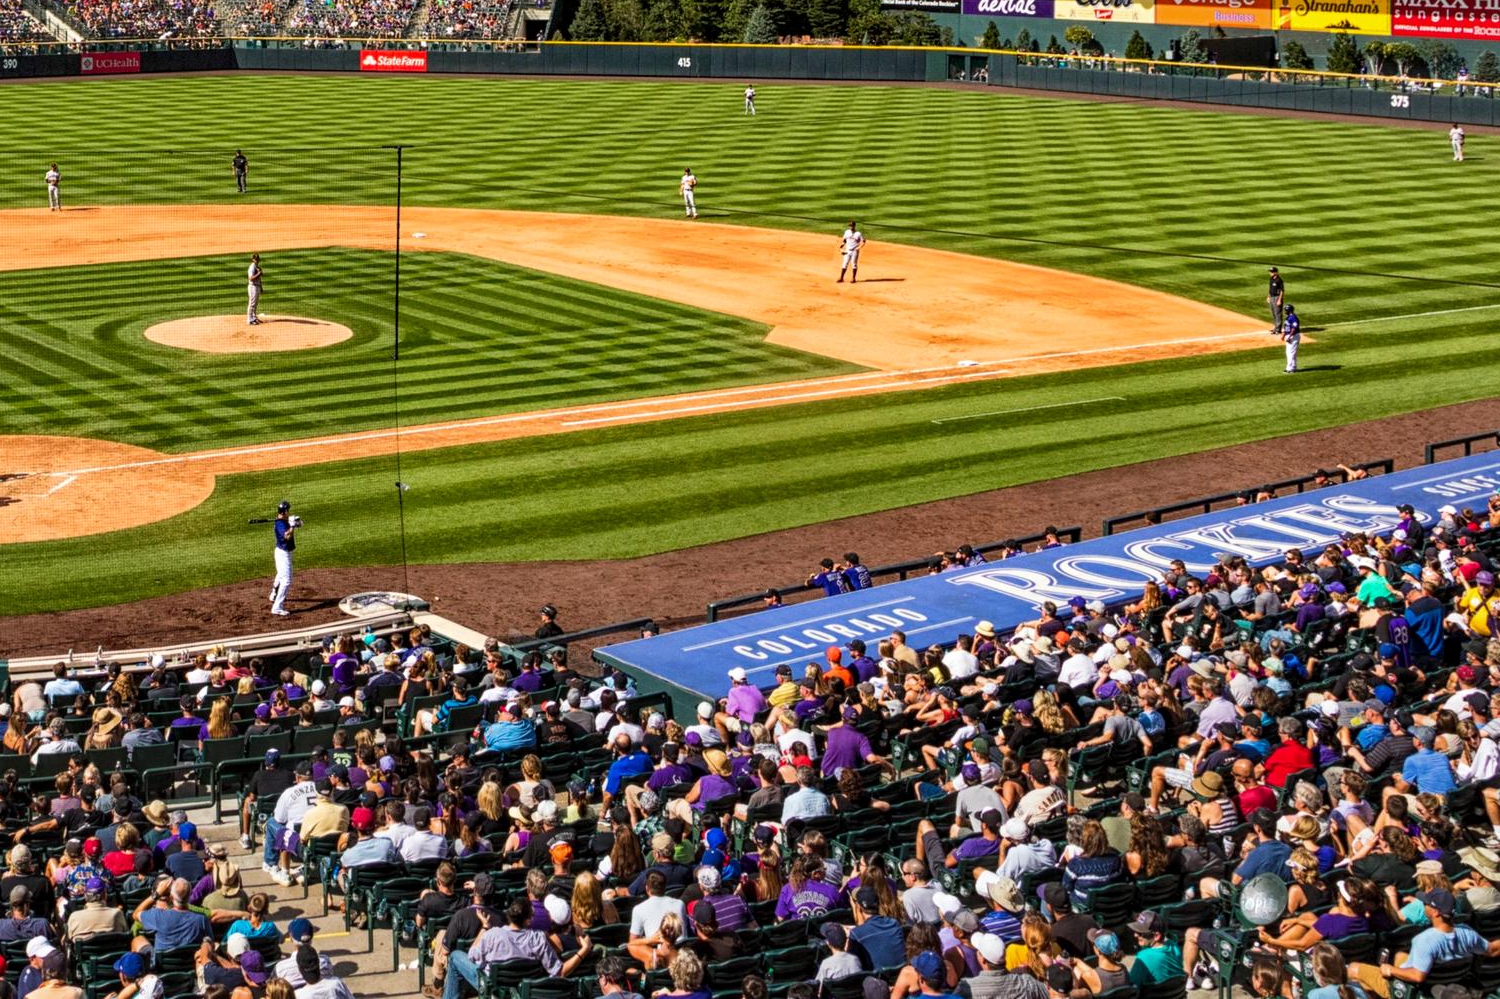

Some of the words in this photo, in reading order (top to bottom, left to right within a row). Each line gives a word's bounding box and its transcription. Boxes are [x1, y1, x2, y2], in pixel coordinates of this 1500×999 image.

[1214, 11, 1254, 23] Business
[3, 59, 17, 69] 390
[96, 58, 139, 68] UCHealth
[678, 57, 691, 68] 415
[1390, 95, 1409, 107] 375
[1423, 474, 1495, 497] SINCE
[946, 493, 1432, 612] ROCKIES
[733, 606, 929, 661] COLORADO
[1395, 625, 1409, 645] 28
